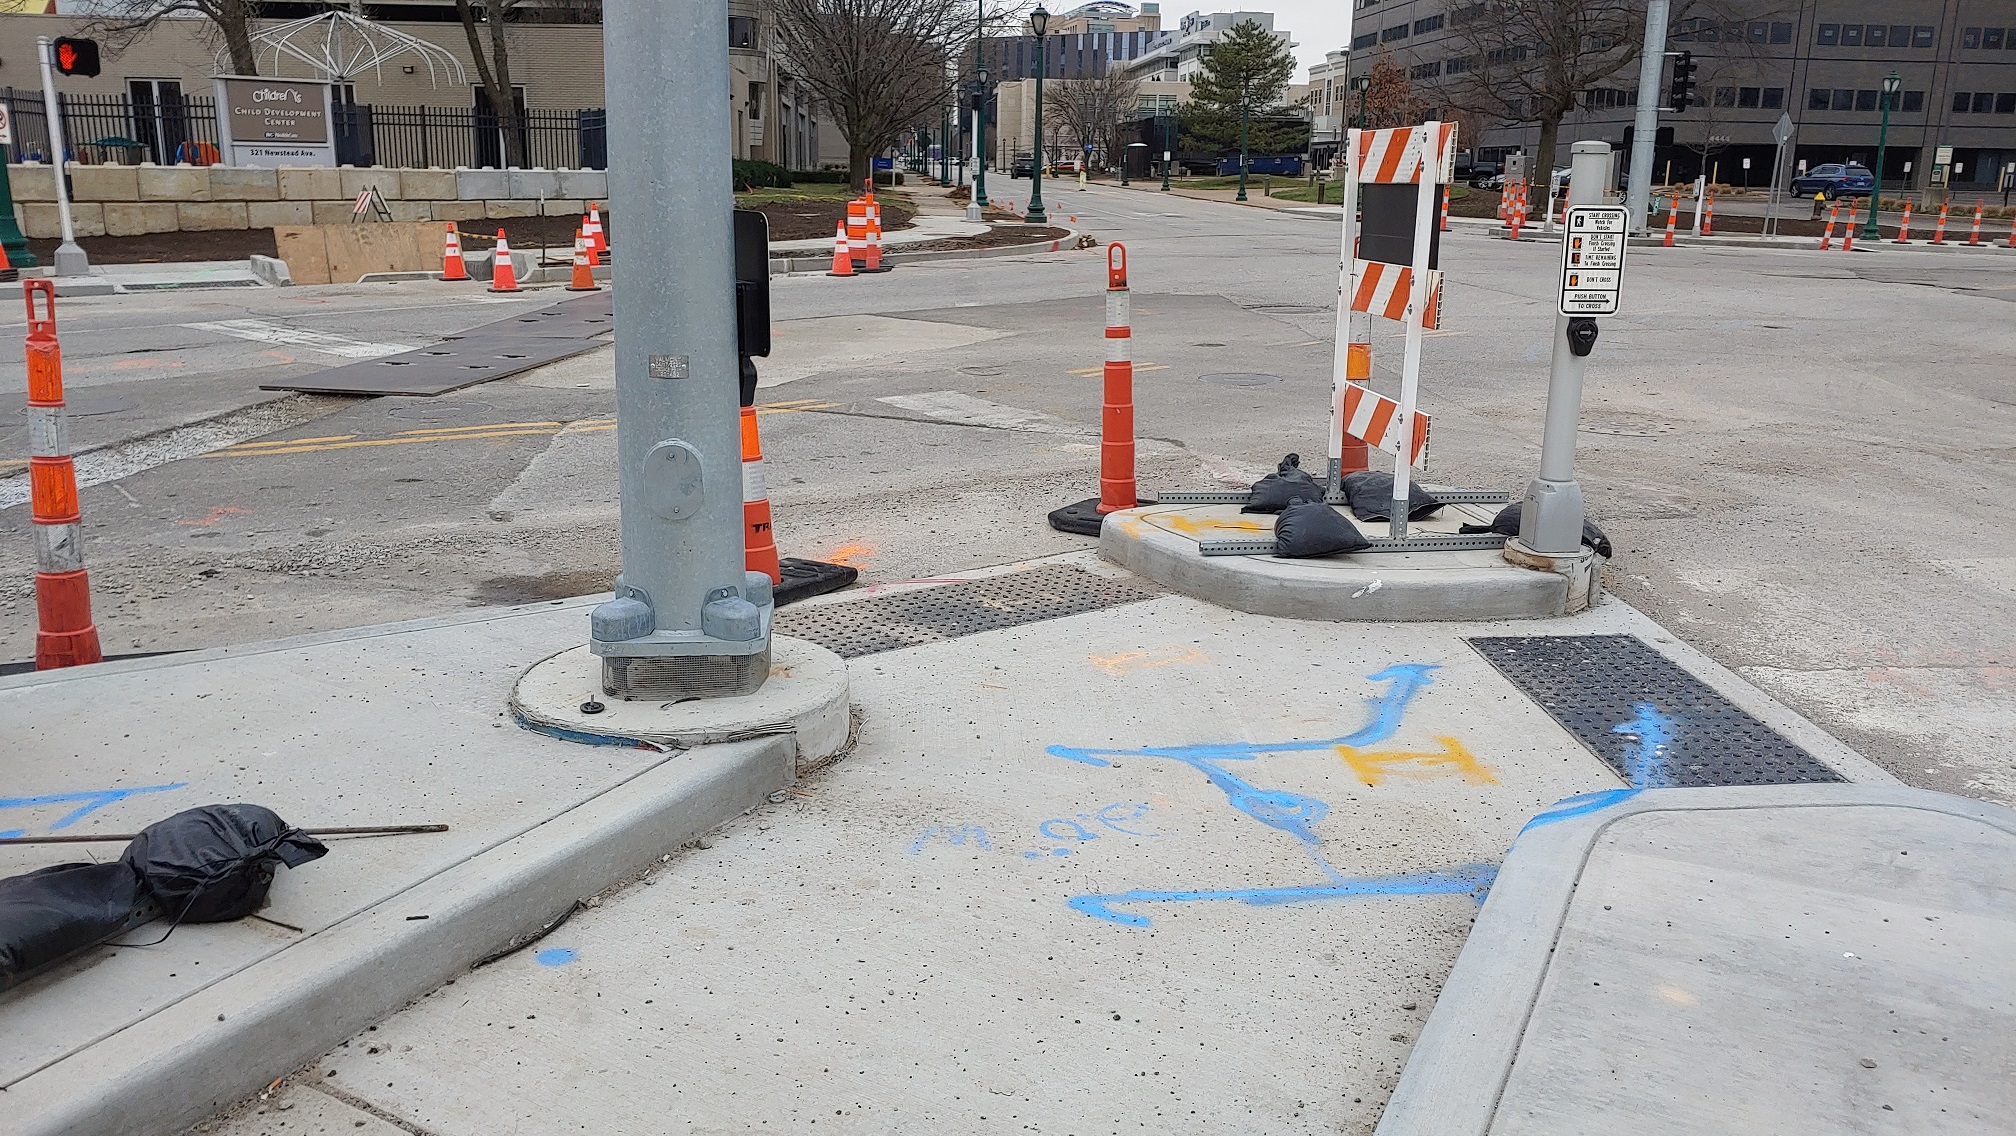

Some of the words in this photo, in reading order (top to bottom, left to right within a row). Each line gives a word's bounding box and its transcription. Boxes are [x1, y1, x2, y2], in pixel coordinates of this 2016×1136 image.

[264, 107, 321, 118] DEVELOPMENT
[264, 117, 296, 126] CENTER
[250, 149, 262, 157] 321
[264, 149, 299, 157] Newstead
[752, 522, 771, 533] TR
